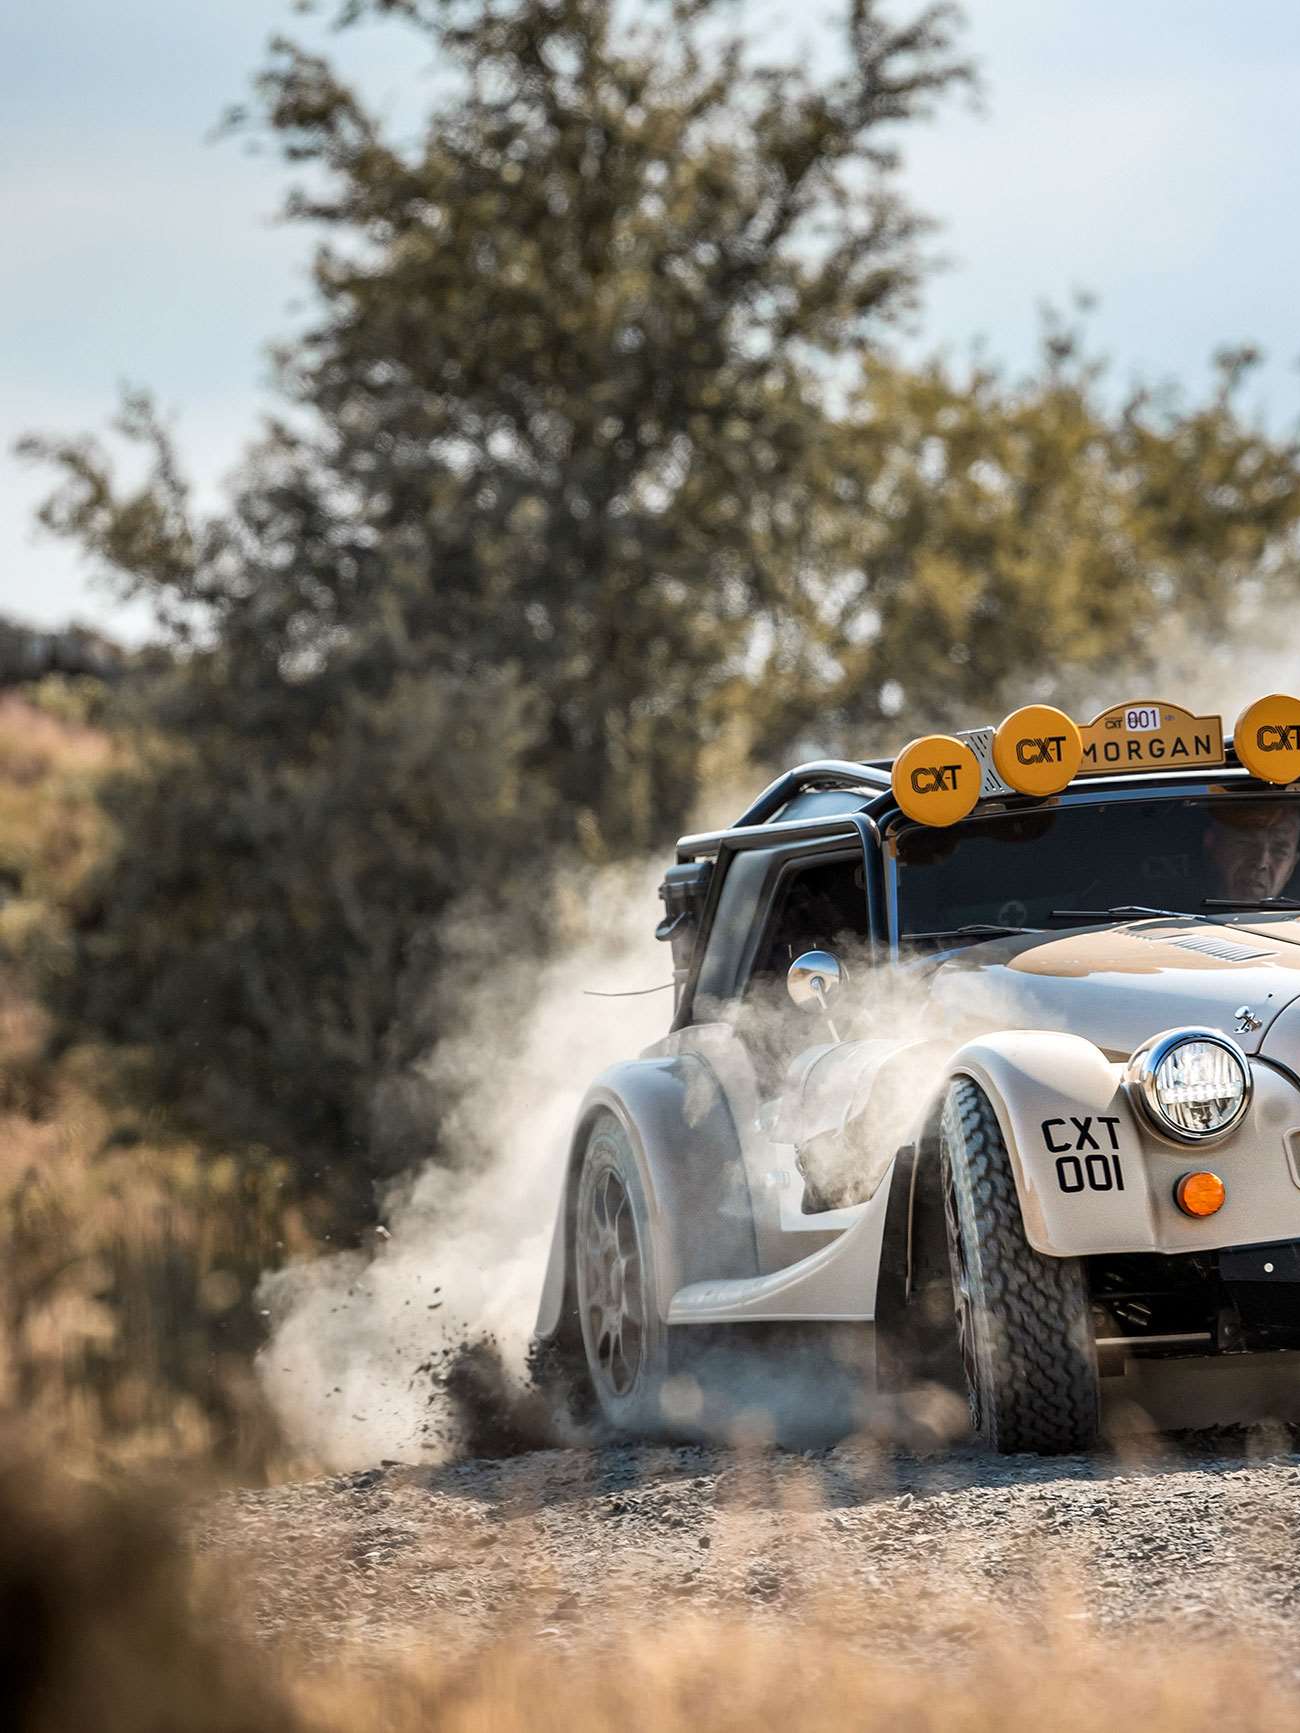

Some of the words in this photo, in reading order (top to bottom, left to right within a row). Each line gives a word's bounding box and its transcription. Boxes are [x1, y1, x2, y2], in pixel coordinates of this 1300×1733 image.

[1081, 735, 1211, 763] MORGAN
[1041, 1117, 1120, 1153] CXT
[1055, 1154, 1125, 1194] 001
